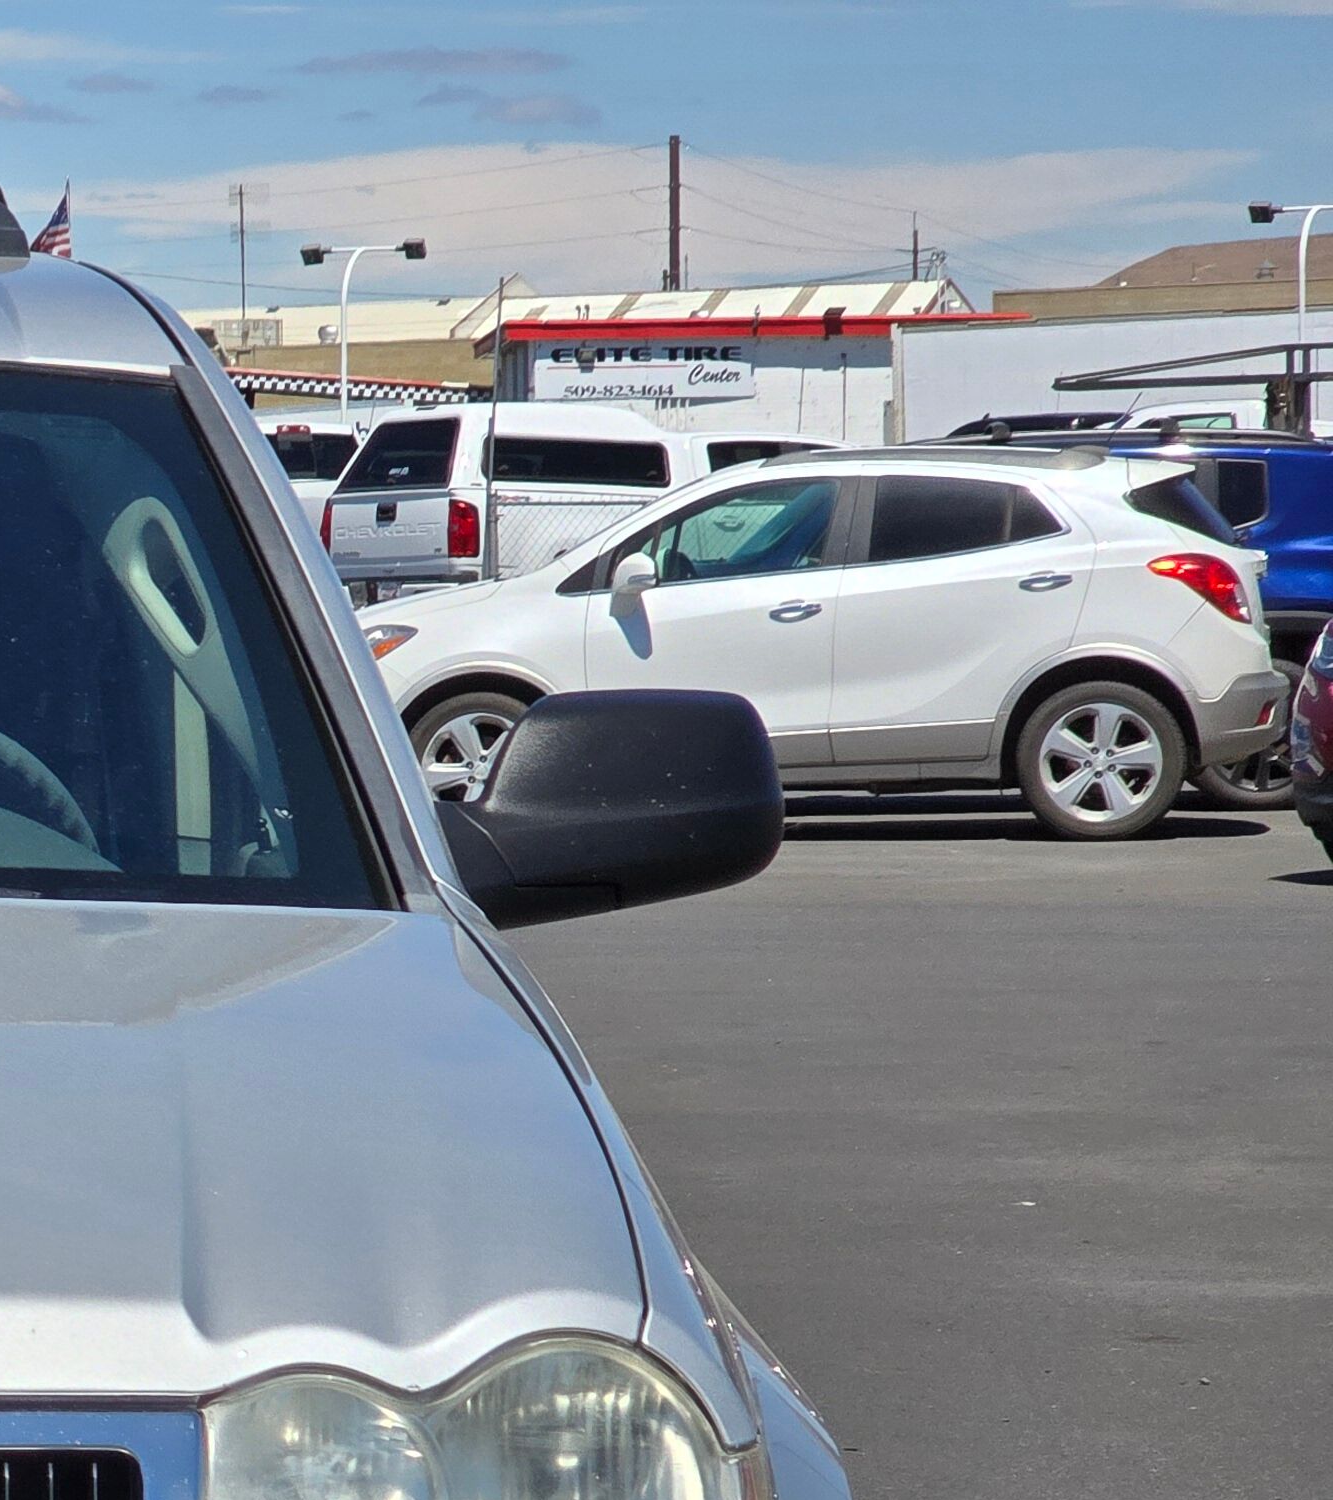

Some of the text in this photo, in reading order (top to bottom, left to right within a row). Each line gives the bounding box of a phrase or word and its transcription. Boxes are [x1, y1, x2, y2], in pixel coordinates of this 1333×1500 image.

[550, 345, 742, 363] EITE TIRE
[688, 363, 742, 386] Center
[334, 522, 441, 540] CHEVROLET
